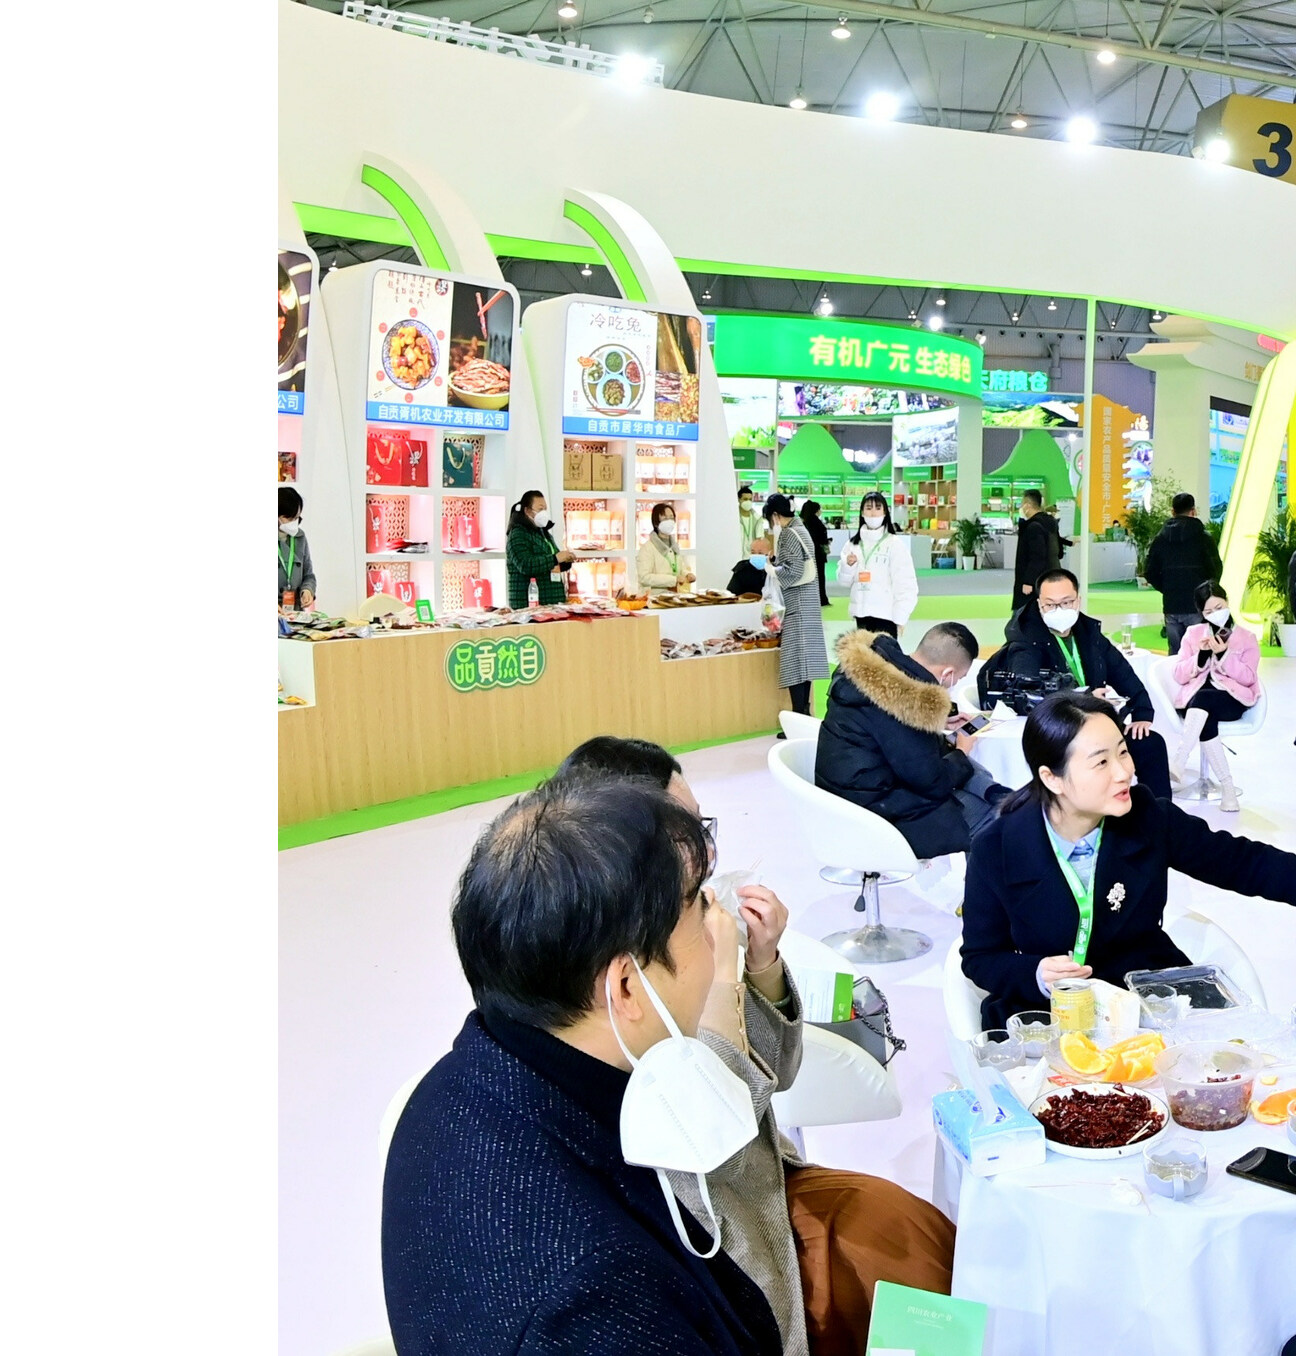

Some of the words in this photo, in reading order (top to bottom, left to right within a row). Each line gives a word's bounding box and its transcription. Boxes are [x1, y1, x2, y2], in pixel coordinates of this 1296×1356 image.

[1252, 122, 1293, 178] 3
[590, 313, 642, 333] 冷吃兔
[809, 335, 911, 374] 有机广元
[915, 346, 972, 384] 生态绿色
